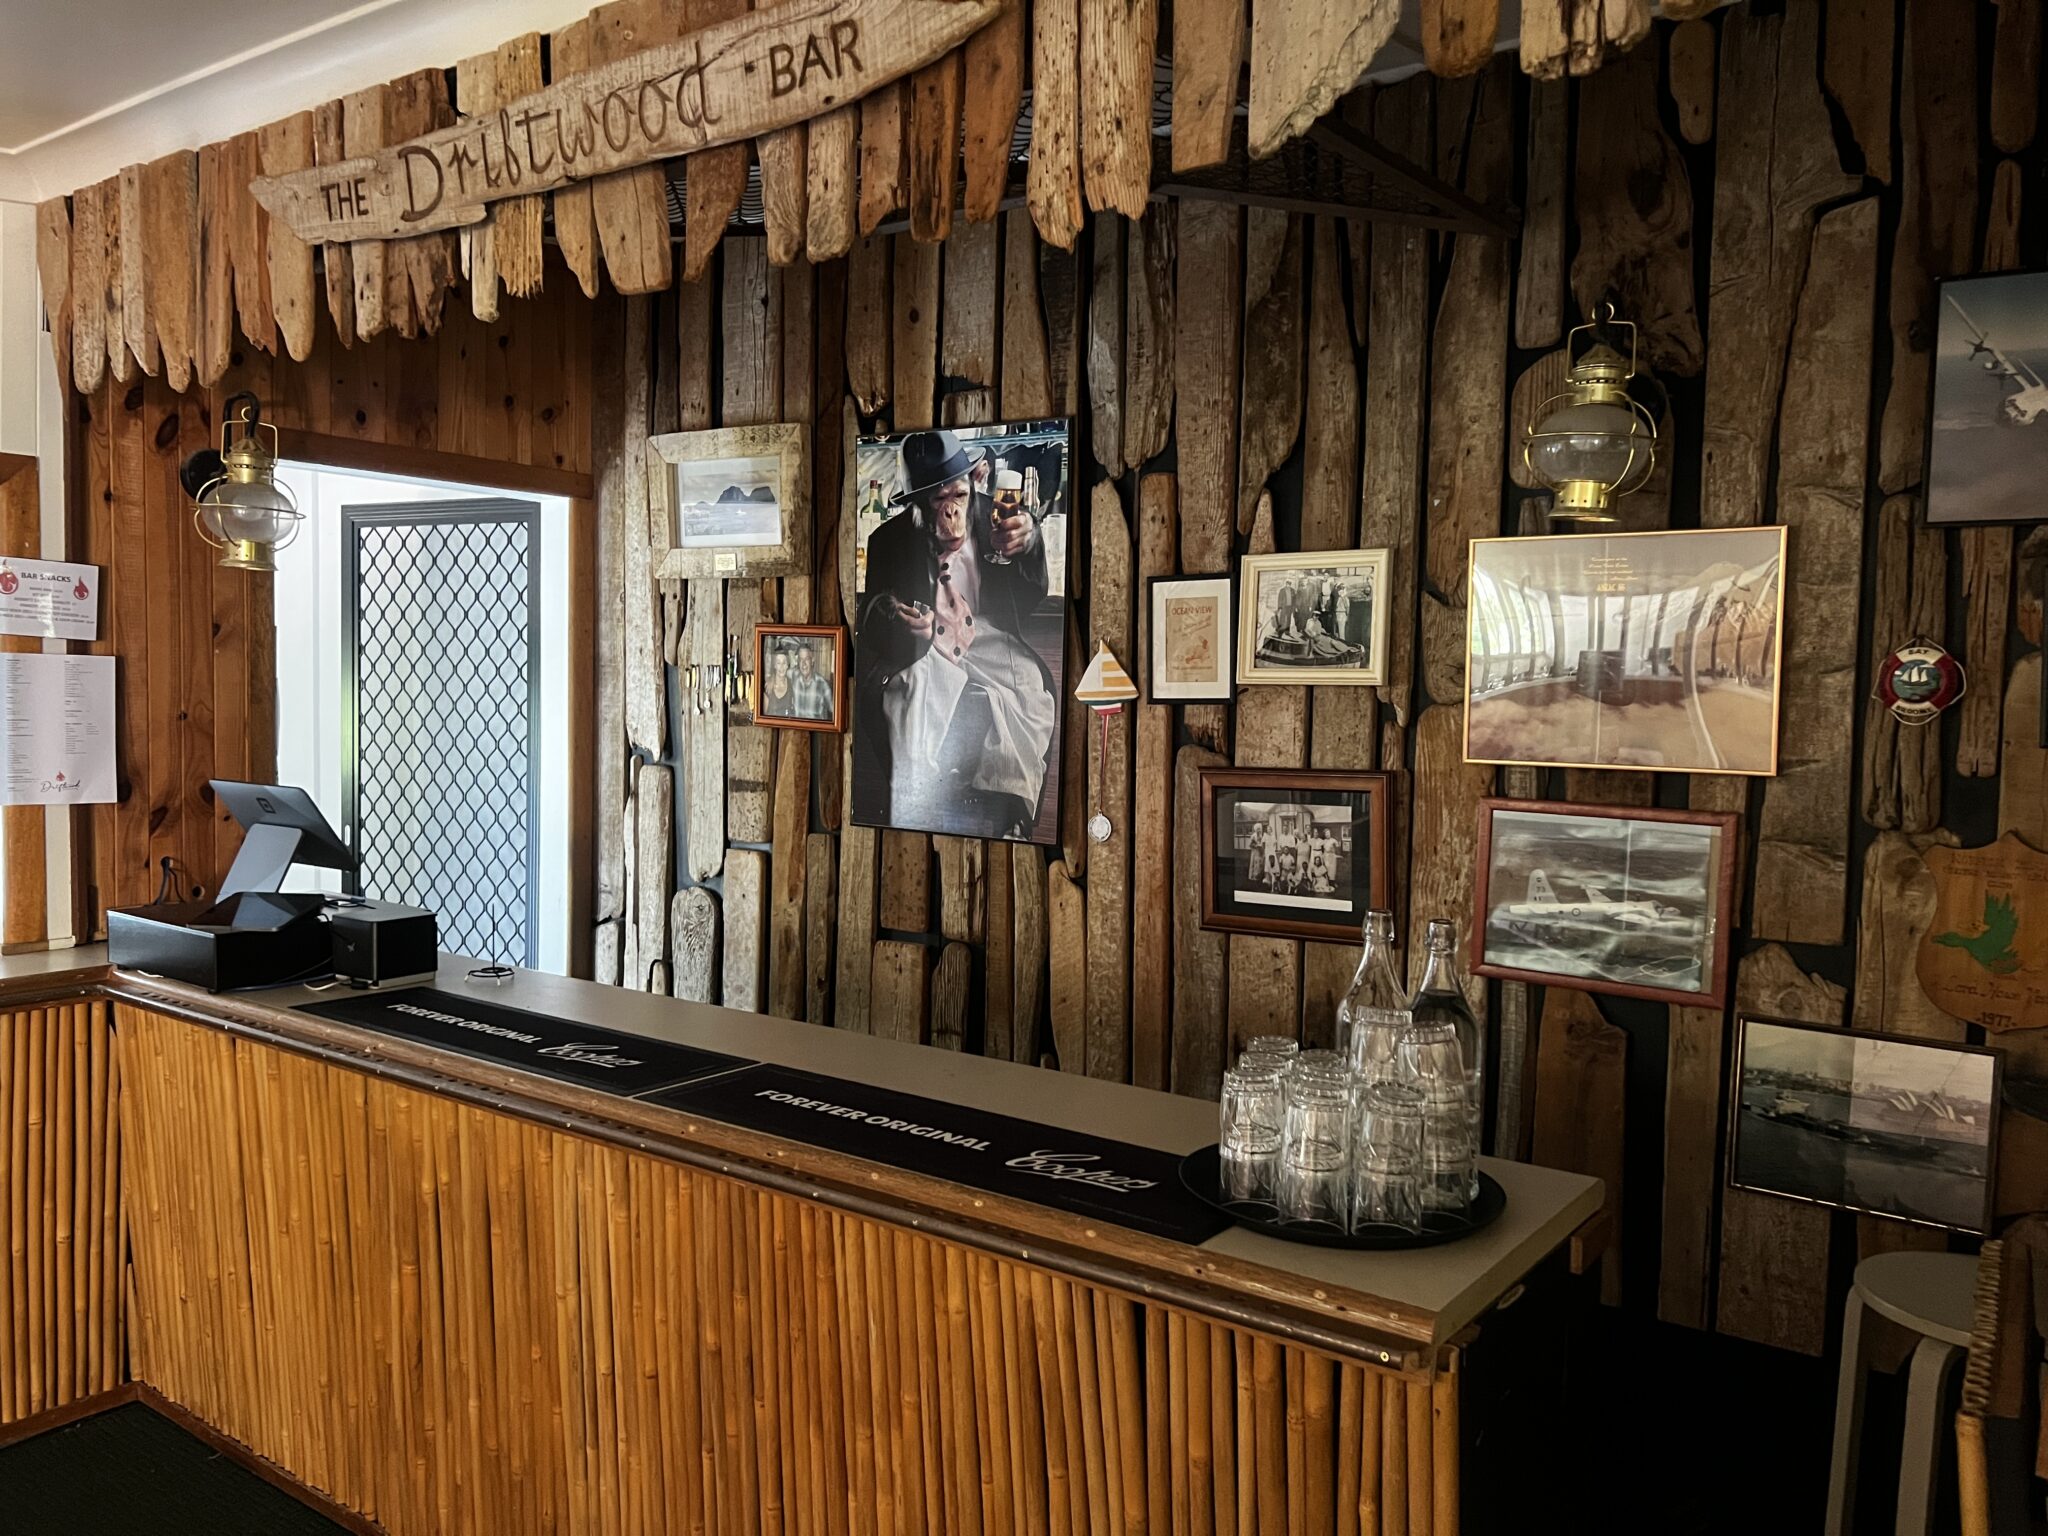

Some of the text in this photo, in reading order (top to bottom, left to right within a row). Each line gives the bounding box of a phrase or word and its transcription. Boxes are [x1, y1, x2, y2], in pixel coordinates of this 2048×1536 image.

[320, 19, 863, 222] THE Driftwood BAR
[21, 572, 38, 580] BAR
[1172, 606, 1212, 616] OCEAN VIEW
[387, 1003, 465, 1024] FOREVER
[457, 1020, 543, 1044] ORIGINAL
[755, 1089, 1160, 1192] FOREVER ORIGINAL Coopers
